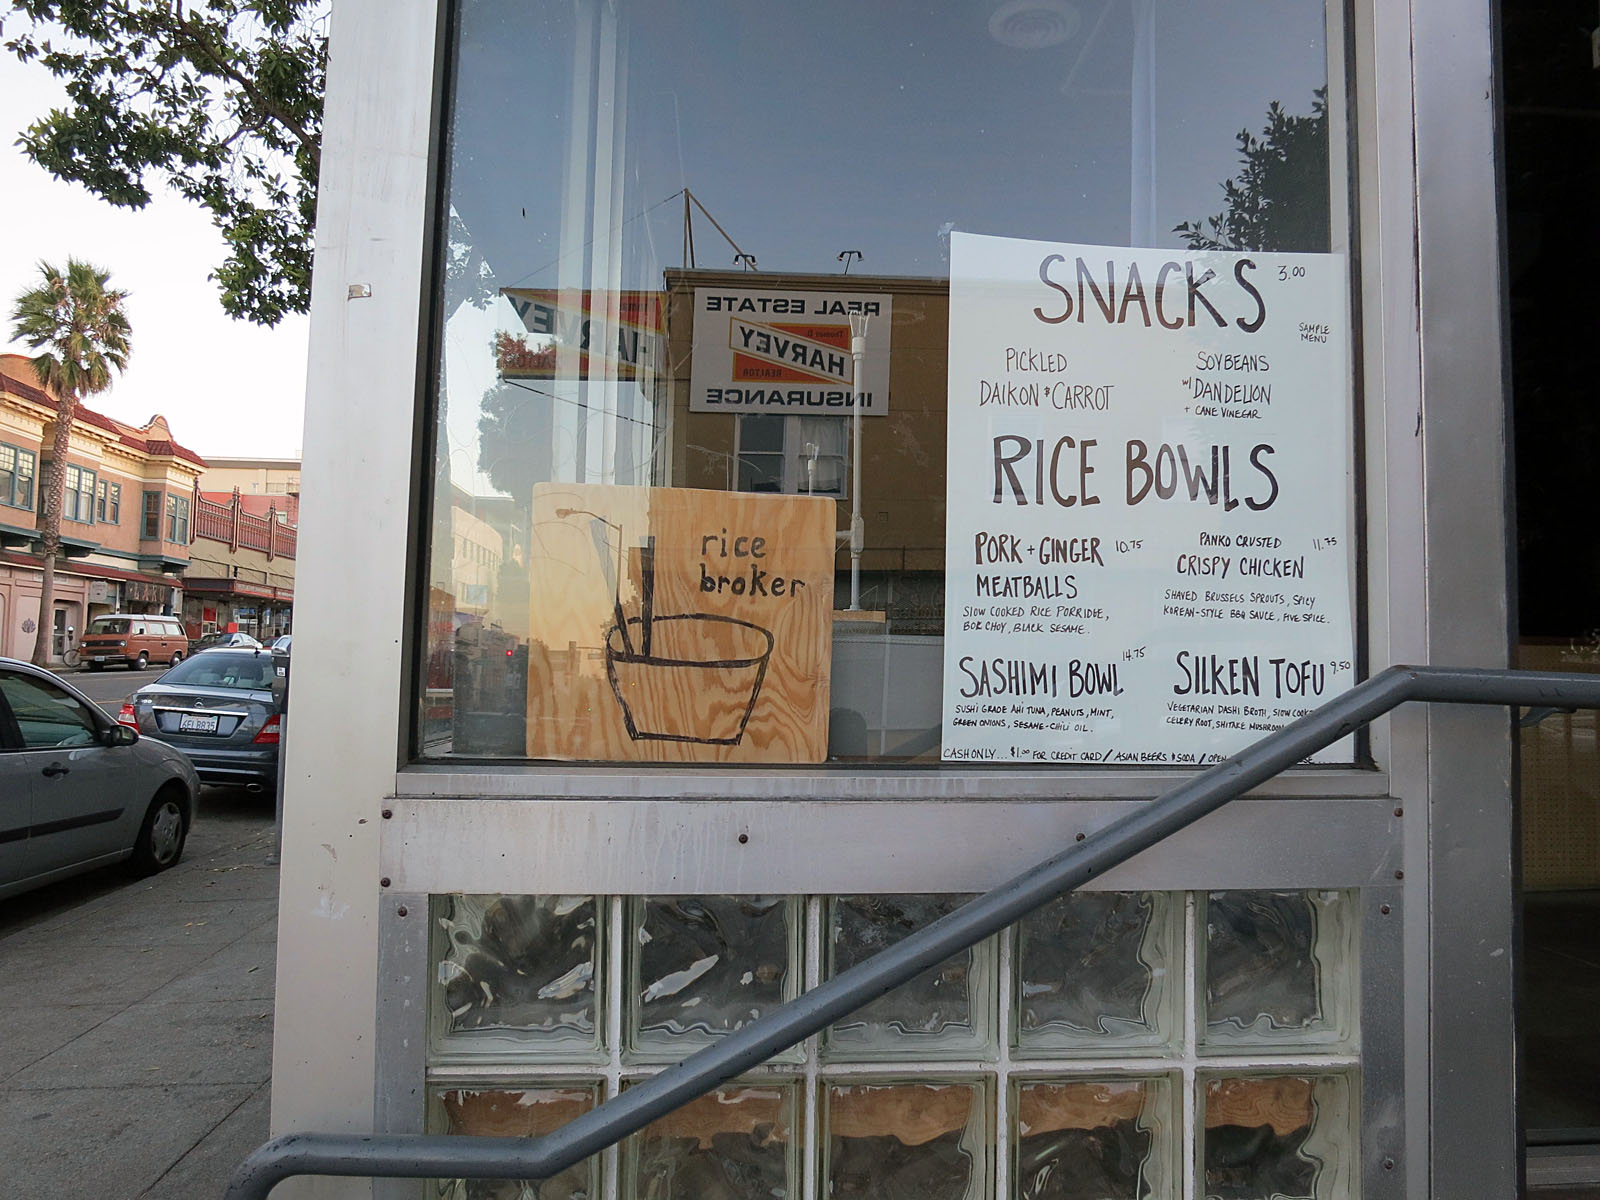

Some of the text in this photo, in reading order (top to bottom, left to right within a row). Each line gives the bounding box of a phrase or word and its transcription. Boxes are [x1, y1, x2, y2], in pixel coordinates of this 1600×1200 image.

[1277, 265, 1306, 281] 3.00
[1033, 254, 1266, 333] SNACKS
[1298, 322, 1330, 335] SAMPLE
[1301, 333, 1327, 343] MENU
[1006, 347, 1067, 372] PICKLED
[1196, 351, 1270, 372] SOYBEANS
[979, 380, 1039, 407] DAIKON
[1052, 381, 1115, 410] CARROT
[1193, 378, 1272, 405] DANDELION
[1195, 405, 1218, 417] CANE
[1221, 407, 1262, 419] VINEGAR
[992, 435, 1280, 513] RICE BOWLS
[701, 528, 766, 558] rice
[975, 531, 1023, 564] PORK
[1039, 536, 1104, 567] GINGER
[1115, 539, 1144, 553] 10.75
[1199, 531, 1282, 549] PANKO CRUSTED
[1312, 537, 1337, 551] 11.75
[1176, 553, 1304, 579] CRISPY CHICKEN
[700, 563, 805, 598] broker
[976, 573, 1078, 599] MEATBALLS
[1164, 588, 1198, 601] SHAVED
[1204, 590, 1245, 603] BRUSSELS
[1292, 594, 1315, 610] SPICY
[963, 605, 986, 617] SLOW
[990, 605, 1025, 617] COOKED
[1030, 606, 1051, 617] RICE
[1163, 604, 1224, 619] KOREAN-STYLE
[1230, 609, 1245, 620] BBQ
[1283, 613, 1300, 622] FIVE
[963, 621, 982, 631] BOK
[1013, 623, 1044, 633] BLACK
[1173, 650, 1325, 699] SILKEN TOFU
[1329, 660, 1351, 675] 9.50
[958, 656, 1124, 698] SASHIMI BOWL
[955, 702, 979, 713] SUSHI
[981, 704, 1007, 714] GRADE
[1167, 701, 1214, 714] VEGETARIAN
[1218, 704, 1240, 715] DASHI
[953, 718, 977, 727] GREEN
[1166, 716, 1194, 727] CELERY
[1215, 720, 1246, 730] SHITAKE
[943, 748, 968, 759] CASH
[1033, 750, 1047, 760] FOR
[1050, 748, 1077, 761] CREDIT
[1114, 751, 1139, 761] ASIAN
[1141, 751, 1167, 762] BEERS
[1177, 753, 1195, 763] SODA
